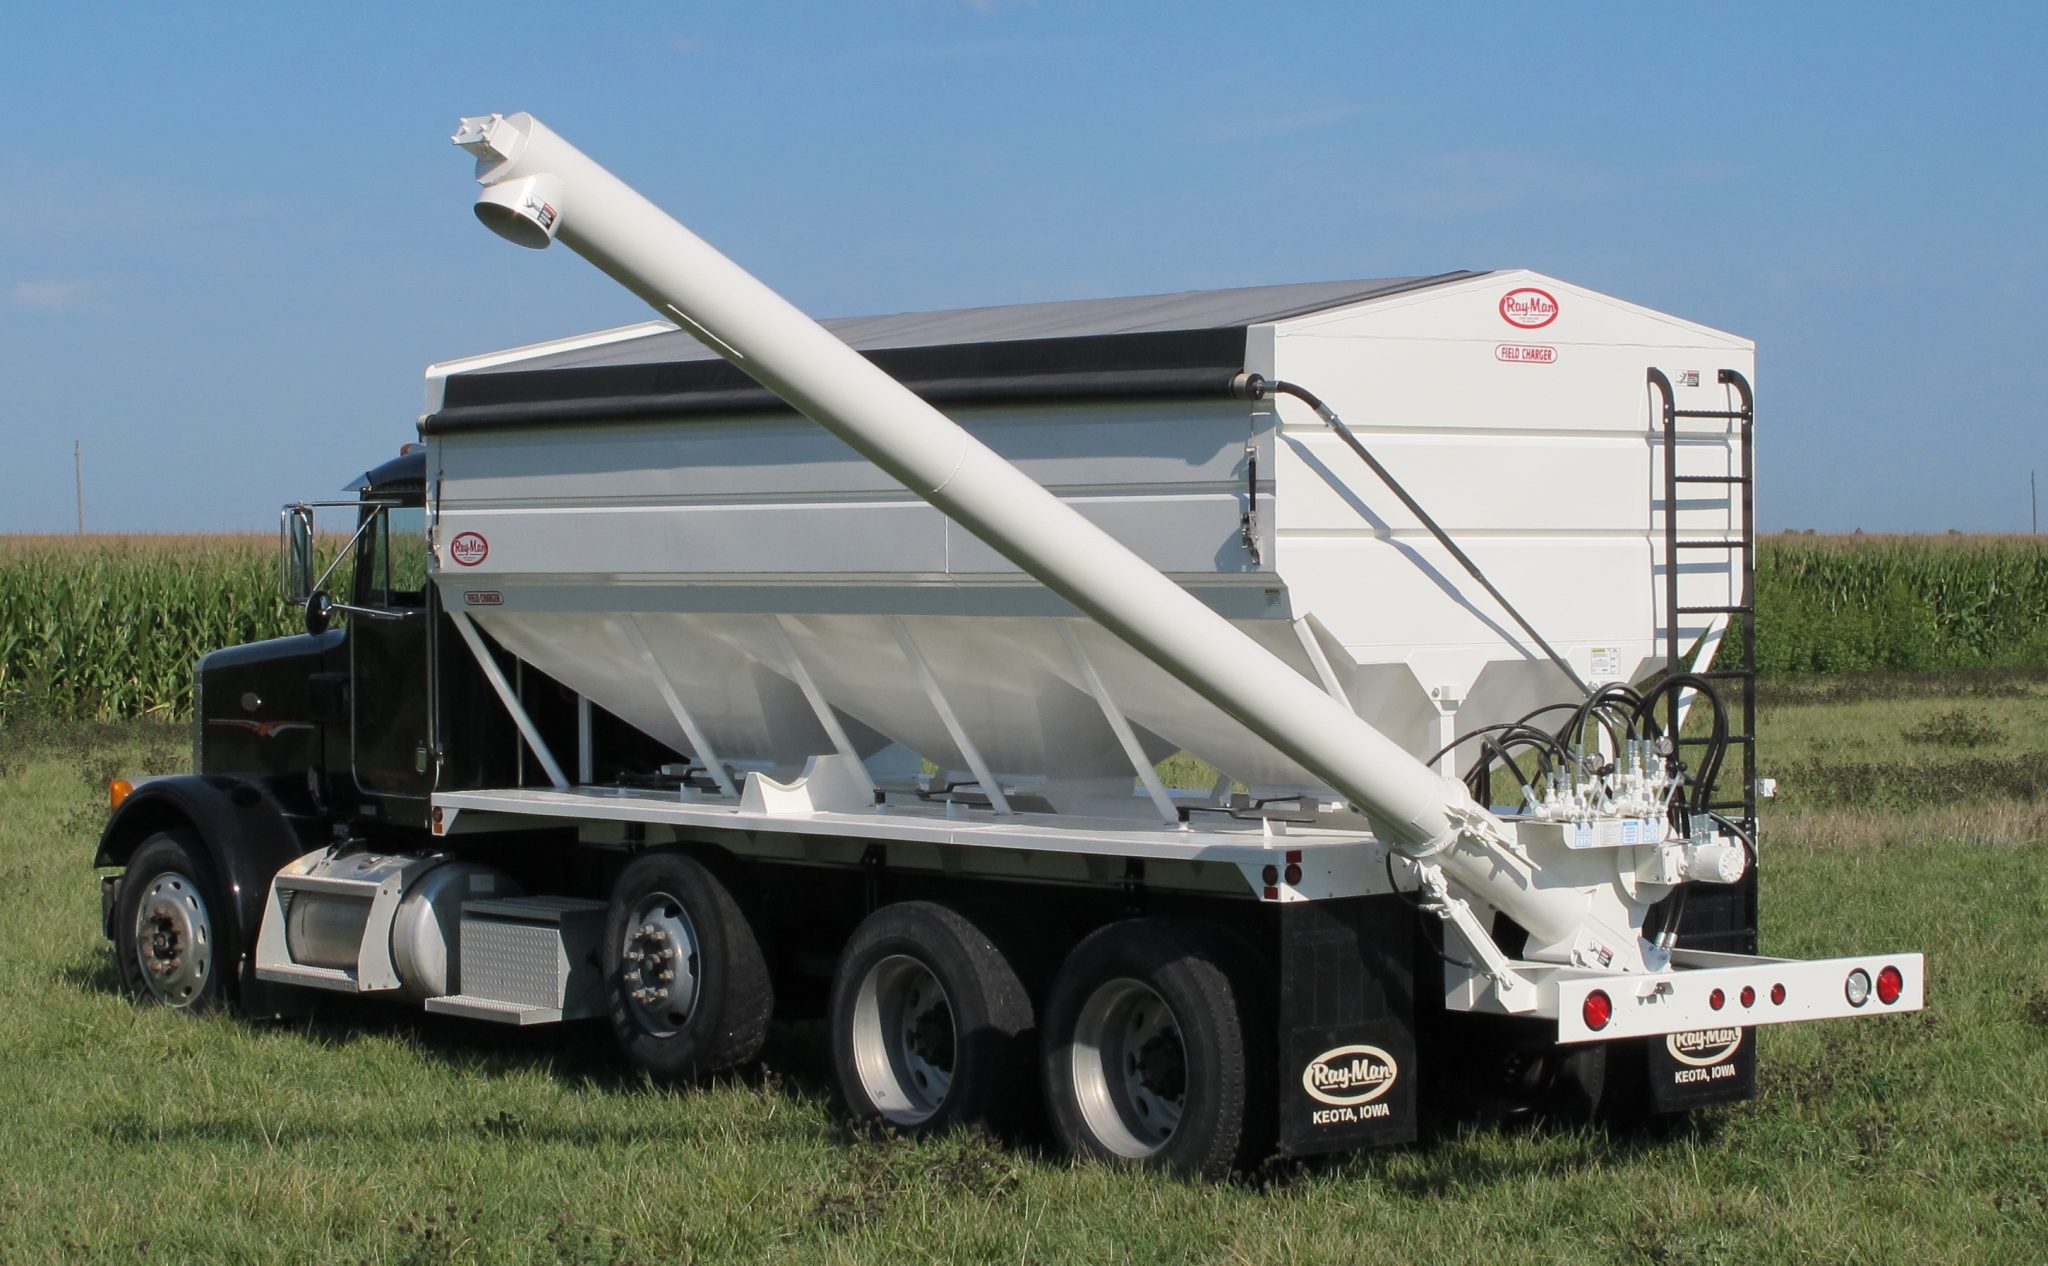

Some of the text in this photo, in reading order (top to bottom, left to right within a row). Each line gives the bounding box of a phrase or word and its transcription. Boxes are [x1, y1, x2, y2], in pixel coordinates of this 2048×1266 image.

[1505, 297, 1555, 316] Ray-Man
[1501, 347, 1552, 361] FIELD CHARGER
[1312, 1059, 1393, 1088] Ray-Man
[1675, 1063, 1736, 1084] KEOTA, IOWA
[1312, 1103, 1390, 1124] KEOTA, IOWA
